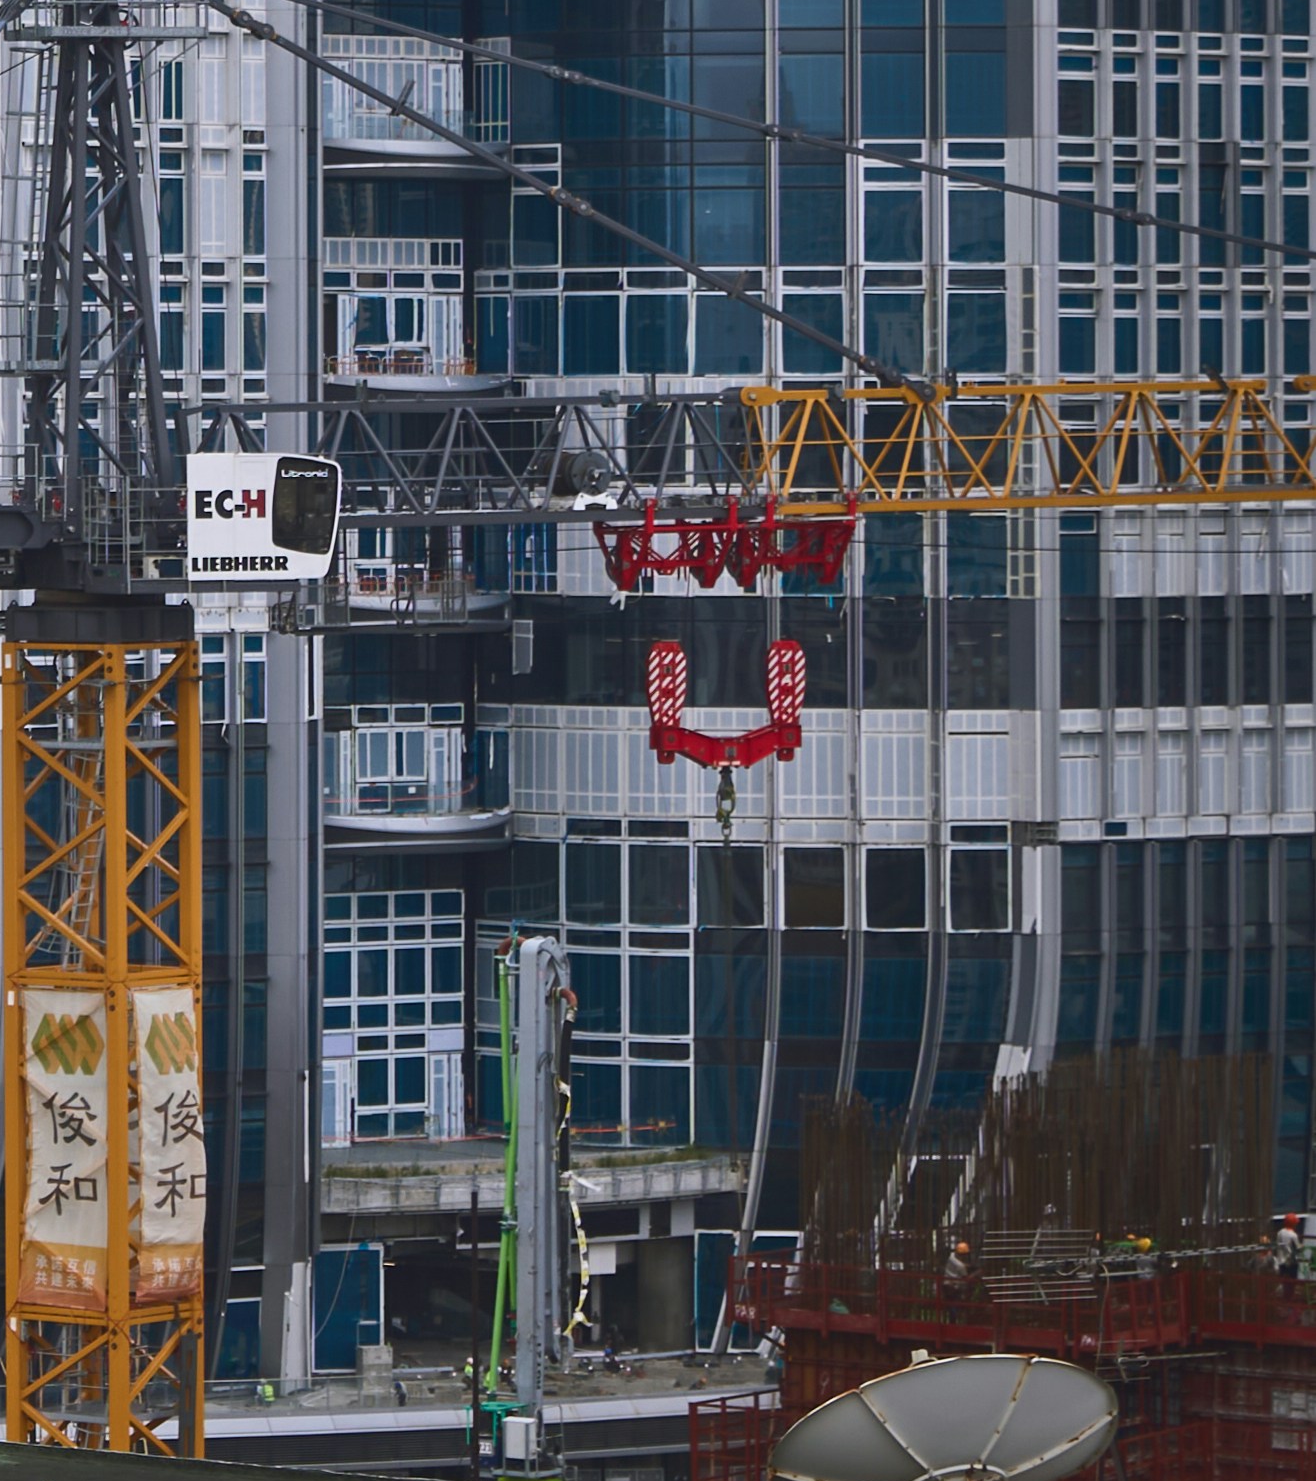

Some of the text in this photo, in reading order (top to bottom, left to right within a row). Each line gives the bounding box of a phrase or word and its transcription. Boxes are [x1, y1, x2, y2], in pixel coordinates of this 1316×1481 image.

[195, 489, 266, 519] EC-H
[192, 556, 288, 572] LIEBHERR
[39, 1091, 98, 1216] 俊和
[154, 1090, 206, 1218] 俊和
